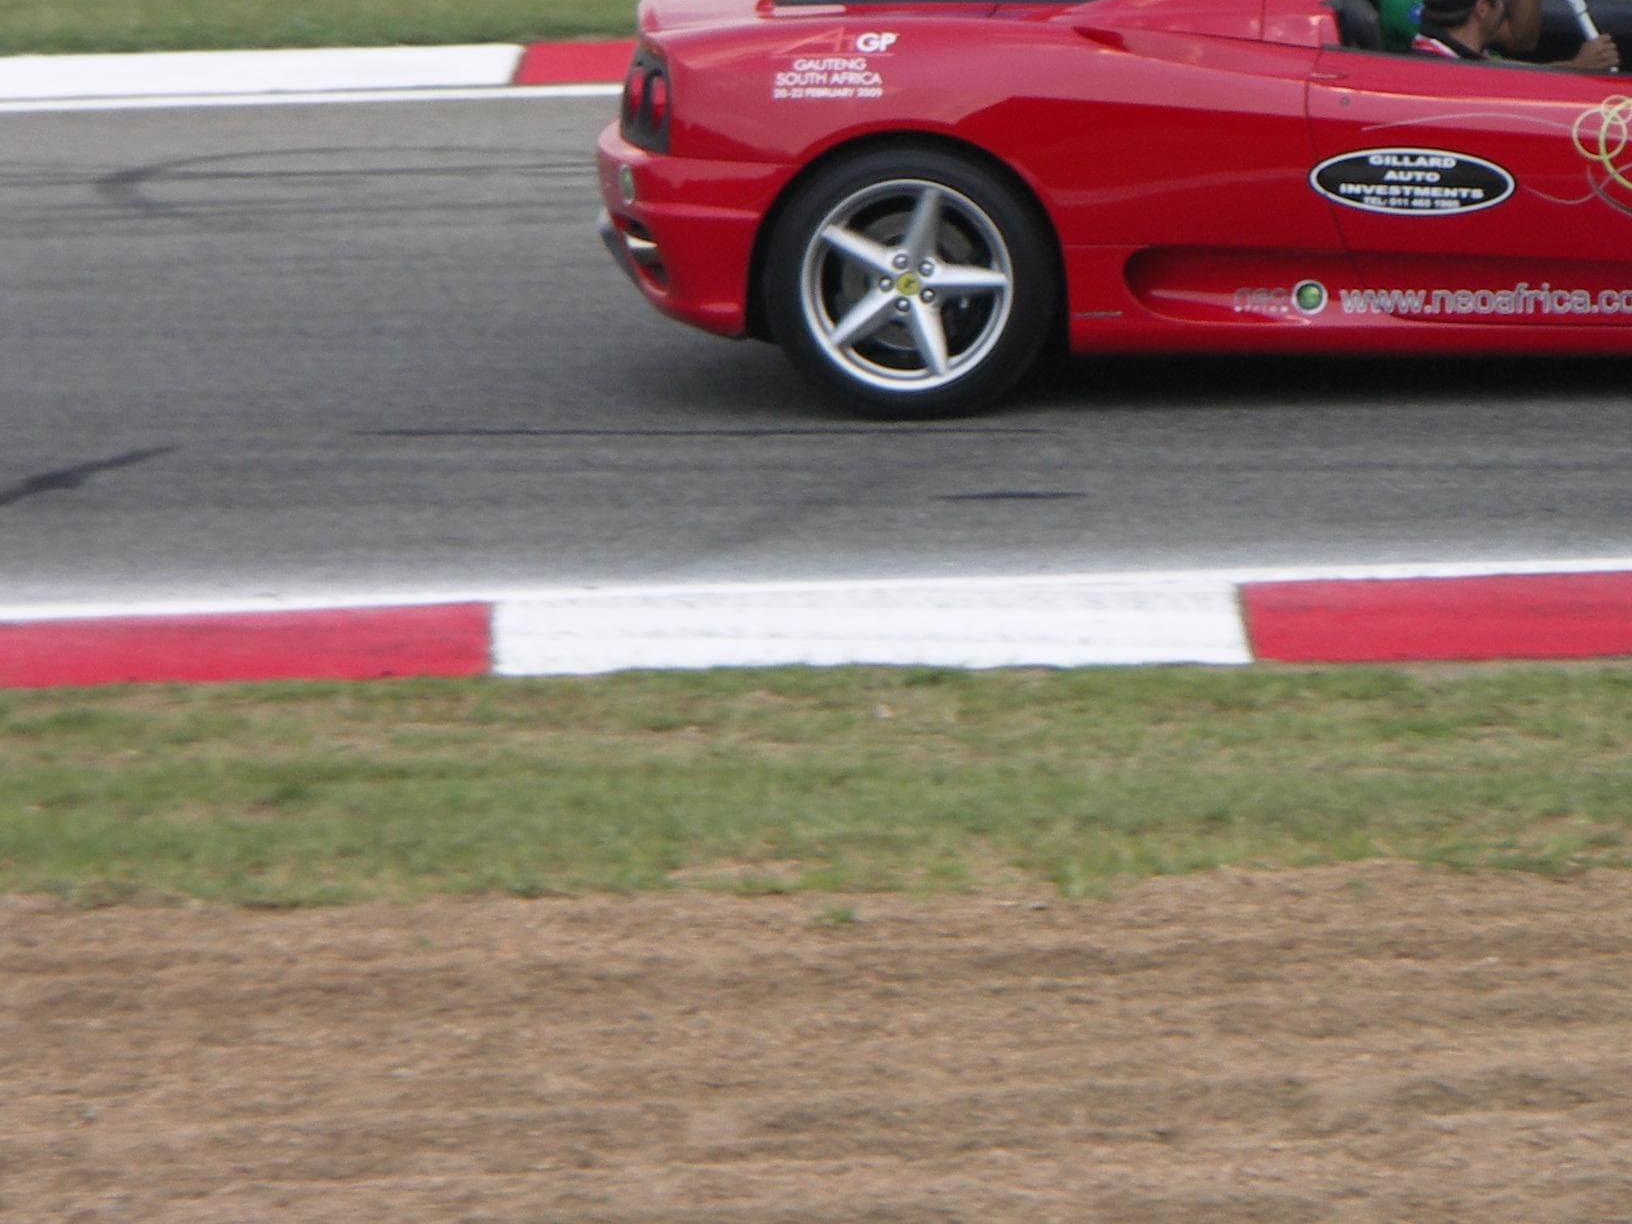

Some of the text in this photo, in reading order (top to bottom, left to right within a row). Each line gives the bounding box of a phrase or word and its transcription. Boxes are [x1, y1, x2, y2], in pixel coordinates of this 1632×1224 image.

[793, 58, 867, 71] GAUTENG
[776, 71, 883, 86] SOUTH AFRICA
[1368, 154, 1457, 169] GILLARD
[1384, 169, 1441, 183] AUTO
[1339, 182, 1484, 199] INVESTMENTS
